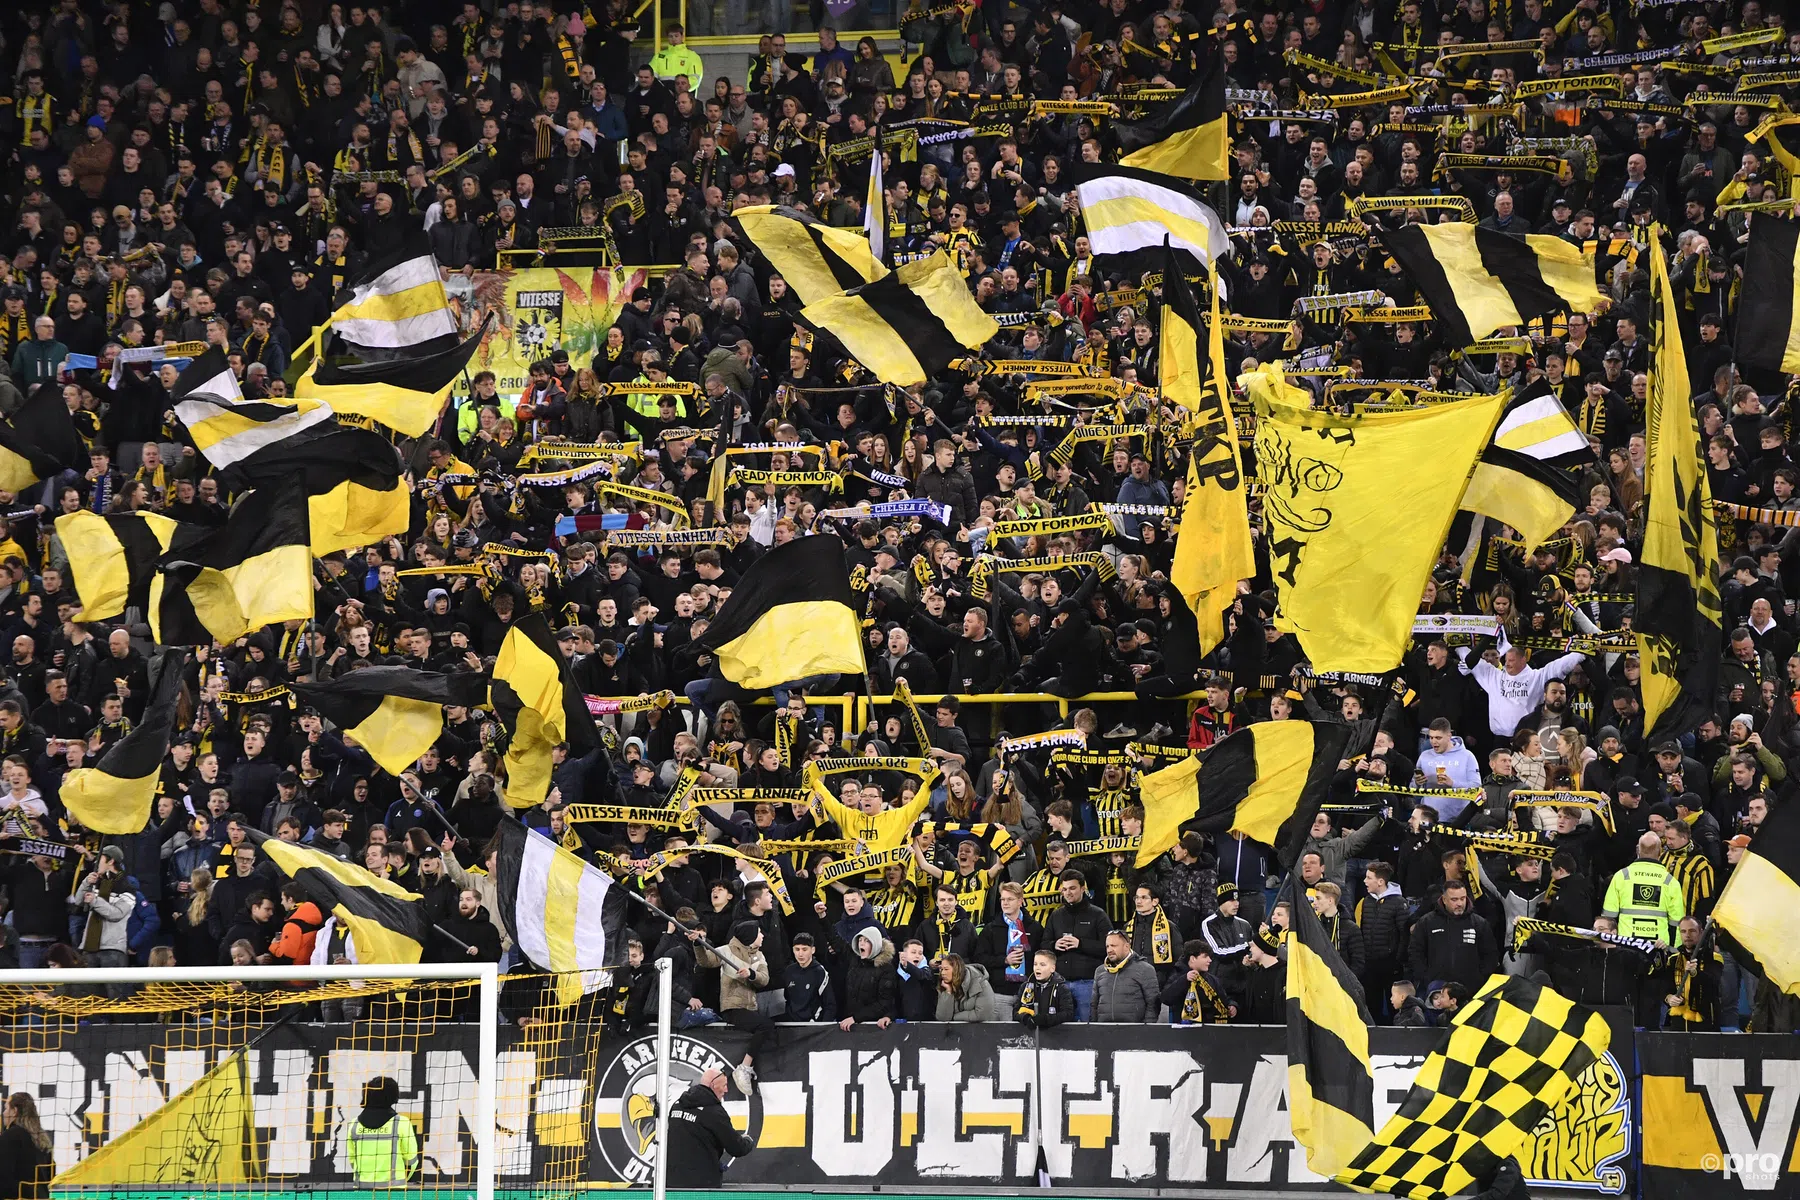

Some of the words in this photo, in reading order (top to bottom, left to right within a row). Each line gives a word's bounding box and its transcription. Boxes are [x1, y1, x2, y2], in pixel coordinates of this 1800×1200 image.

[1584, 53, 1633, 68] GELDERS
[1633, 47, 1670, 63] TROTS
[1742, 55, 1778, 67] VITESSE
[1677, 61, 1709, 73] VITESSE
[1520, 78, 1563, 96] READY
[1563, 76, 1589, 90] FOR
[1338, 93, 1368, 104] VITESSE
[1369, 88, 1402, 100] ARNHEM
[979, 104, 999, 114] ONZE
[999, 102, 1018, 112] CLUB
[1603, 99, 1645, 111] ARNHEM
[1647, 103, 1682, 116] VITESSE
[1242, 109, 1335, 123] VITESSE
[1447, 156, 1486, 165] VITESSE
[1501, 158, 1546, 167] ARNHEM
[1373, 196, 1418, 208] JONGES
[1274, 220, 1321, 233] VITESSE
[519, 291, 561, 307] VITESSE
[1304, 290, 1382, 310] VITESSE
[1390, 307, 1424, 318] ARNHEM
[1002, 365, 1037, 373] ARNHEM
[1040, 365, 1073, 374] VITESSE
[620, 382, 653, 390] VITESSE
[654, 382, 689, 391] ARNHEM
[1065, 384, 1096, 393] generation
[571, 464, 611, 483] ARNHEM
[734, 468, 774, 483] READY
[776, 471, 802, 482] FOR
[871, 468, 907, 486] VITESSE
[616, 485, 651, 500] VITESSE
[652, 494, 686, 511] ARNHEM
[874, 503, 921, 513] CHELSEA
[994, 522, 1039, 536] READY
[1041, 519, 1071, 531] FOR
[1072, 513, 1108, 527] MORE
[617, 531, 664, 544] VITESSE
[666, 530, 718, 543] ARNHEM
[1343, 672, 1384, 687] ARNHEM
[621, 697, 653, 710] VITESSE
[1162, 745, 1189, 757] VOOR
[816, 758, 883, 772] AWAYDAYS
[885, 757, 909, 769] 026
[1051, 755, 1068, 763] VOOR
[1067, 755, 1081, 764] ONZE
[1081, 755, 1098, 764] CLUB
[1098, 755, 1108, 764] EN
[1107, 755, 1125, 765] ONZE
[691, 788, 753, 804] VITESSE
[753, 788, 812, 804] ARNHEM
[569, 805, 625, 819] VITESSE
[20, 838, 66, 858] VITESSE
[997, 838, 1017, 856] 1892
[1106, 836, 1130, 850] UUT
[824, 857, 868, 880] JONGES
[866, 850, 891, 867] UUT
[1633, 870, 1664, 879] STEWARD
[1520, 917, 1575, 936] VITESSE
[1599, 932, 1656, 956] GURAM
[620, 1032, 728, 1077] ARHEM
[683, 1111, 697, 1123] TEAM
[357, 1126, 389, 1136] SERVICE
